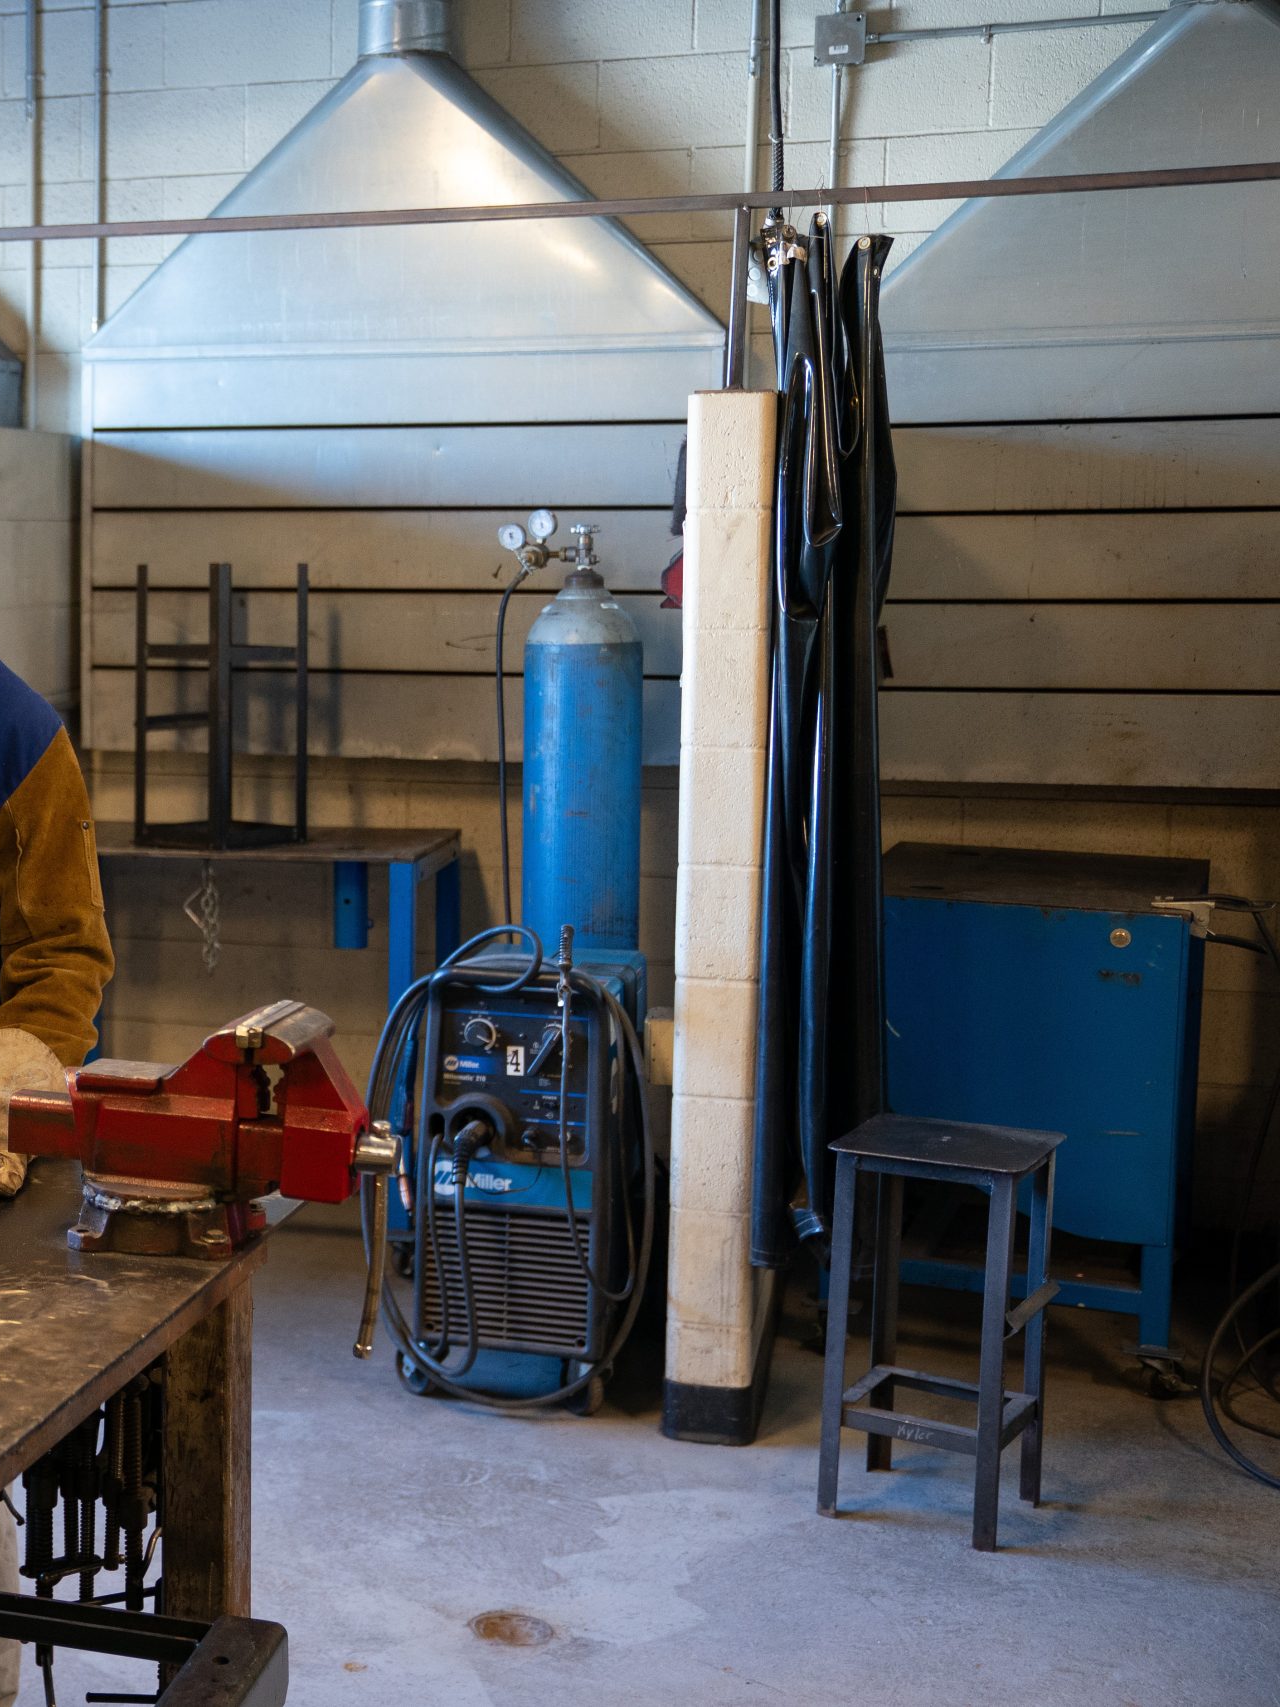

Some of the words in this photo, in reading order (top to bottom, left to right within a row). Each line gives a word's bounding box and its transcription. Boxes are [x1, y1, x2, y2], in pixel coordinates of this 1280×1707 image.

[459, 1060, 480, 1069] Miller
[510, 1049, 521, 1072] 4
[465, 1172, 513, 1192] Miller
